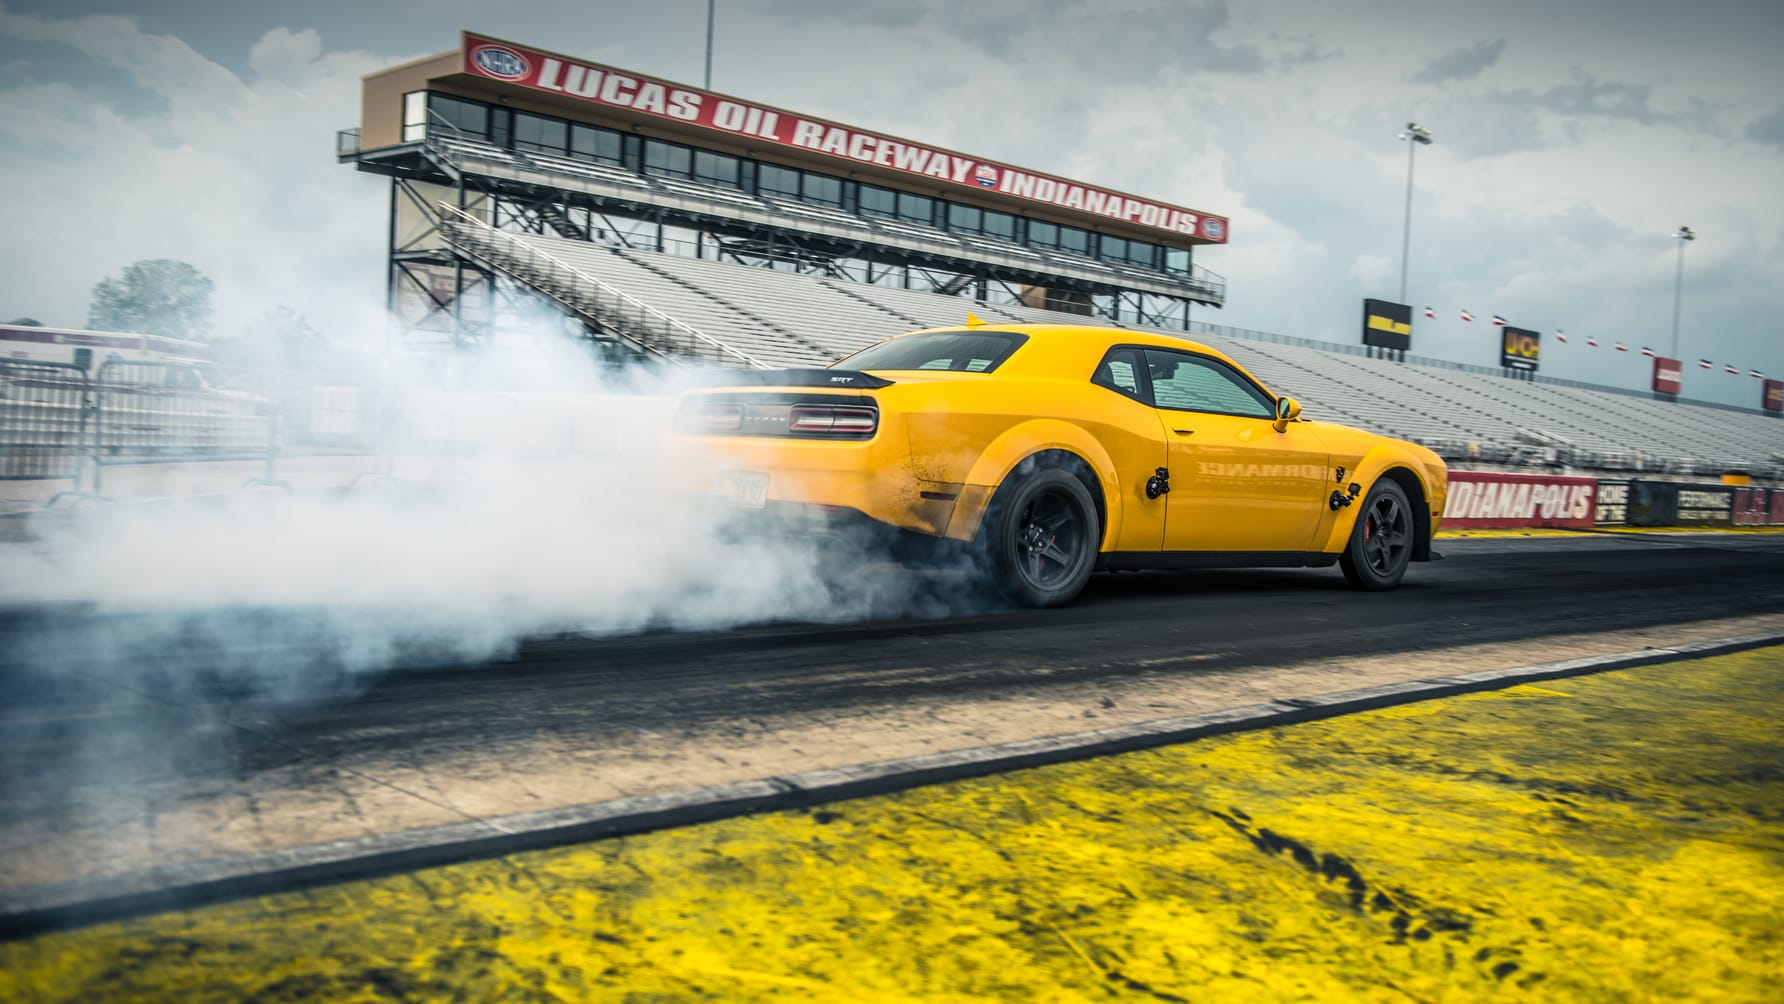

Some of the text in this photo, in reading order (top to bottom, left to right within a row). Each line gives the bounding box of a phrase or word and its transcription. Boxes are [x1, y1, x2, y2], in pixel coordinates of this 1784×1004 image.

[537, 58, 1199, 235] LUCAS OIL RACEWAY INDIANAPOLIS
[830, 376, 854, 384] SRT
